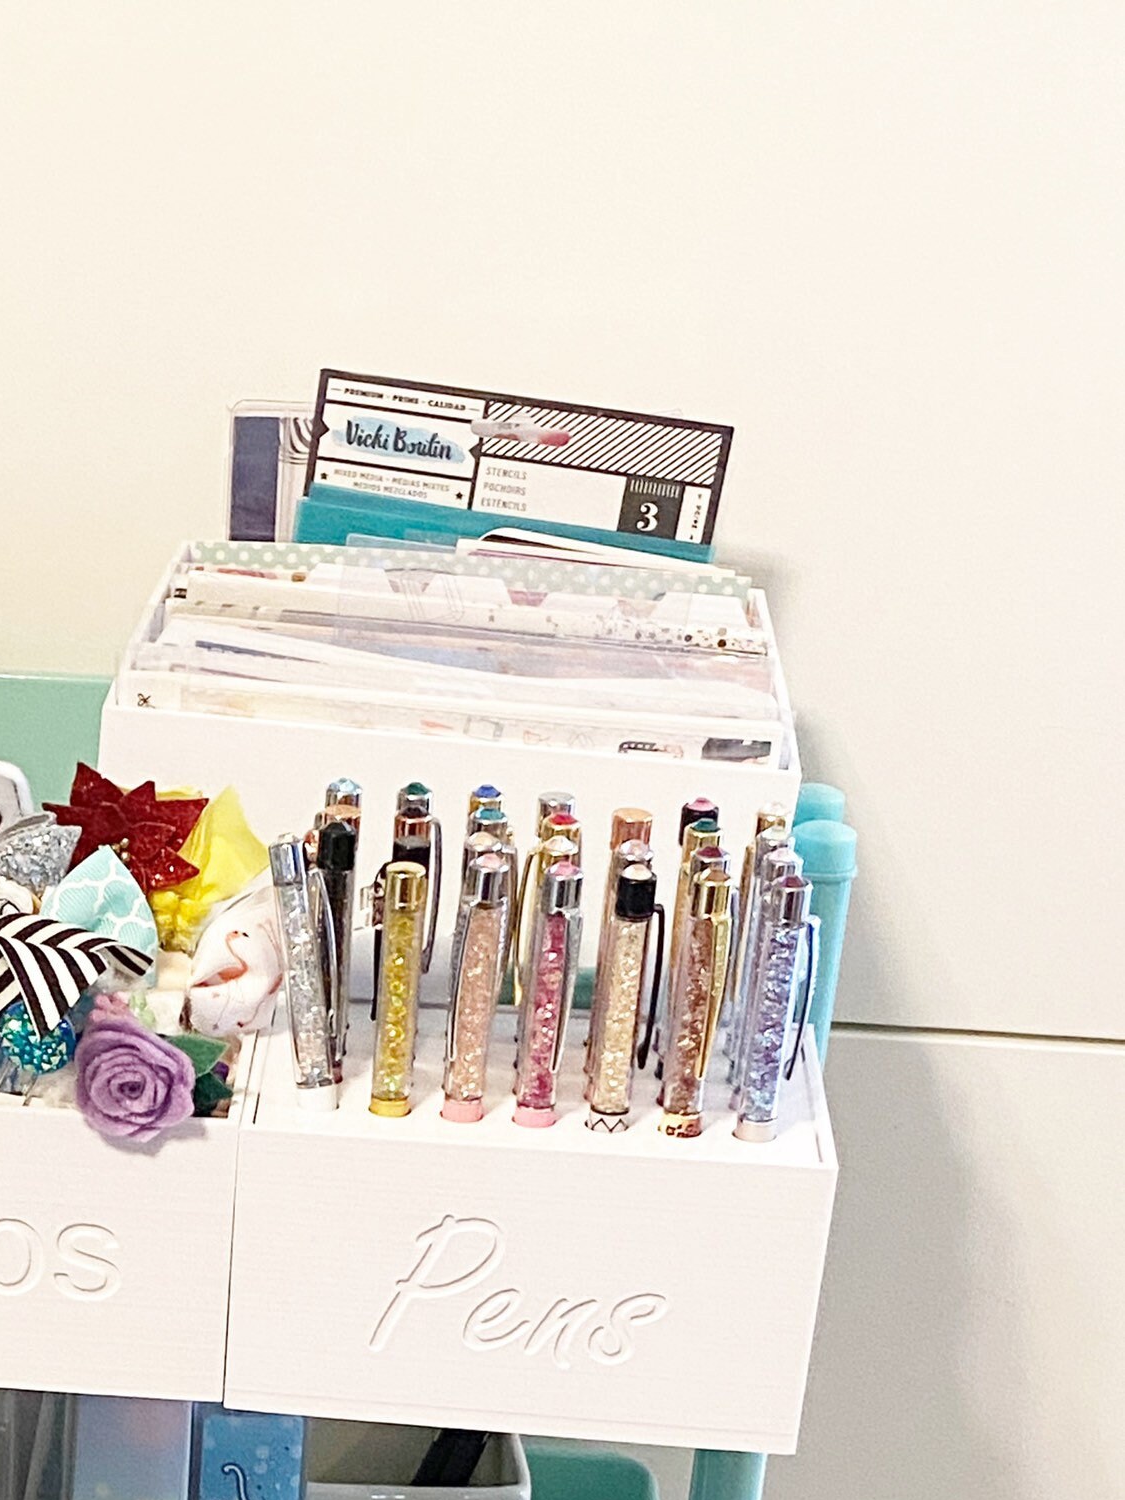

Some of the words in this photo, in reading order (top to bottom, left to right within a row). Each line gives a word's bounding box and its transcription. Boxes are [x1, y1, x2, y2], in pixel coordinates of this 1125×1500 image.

[427, 399, 467, 411] CALIDAD
[345, 419, 390, 451] Vicki
[392, 426, 452, 461] Boutin
[486, 466, 527, 480] STENCILS
[636, 502, 659, 532] 3
[369, 1214, 667, 1370] Pens
